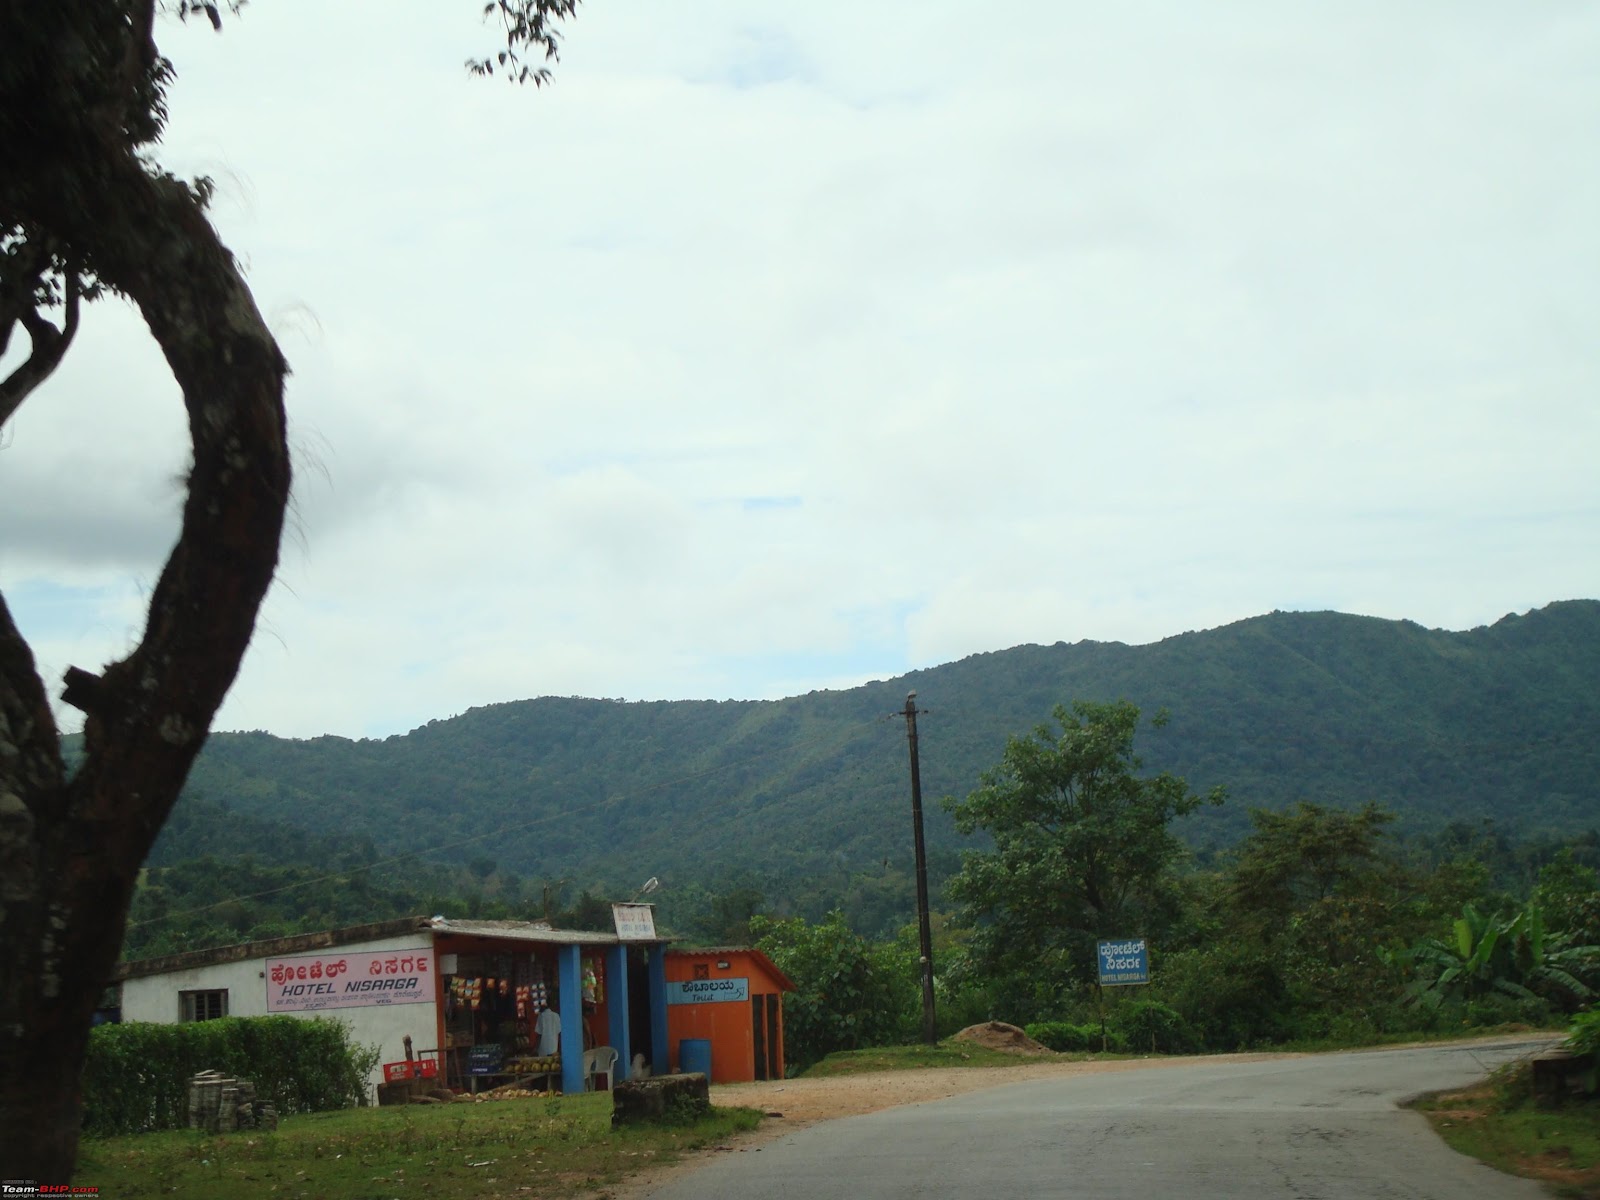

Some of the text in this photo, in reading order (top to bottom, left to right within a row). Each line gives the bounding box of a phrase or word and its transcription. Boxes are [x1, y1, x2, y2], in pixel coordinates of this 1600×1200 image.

[271, 956, 428, 985] ಹೋಟೆಲ್ ನಿಸರ್ಗ
[281, 983, 336, 997] HOTEL
[345, 978, 419, 993] NISARGA
[692, 994, 714, 1002] Toilet
